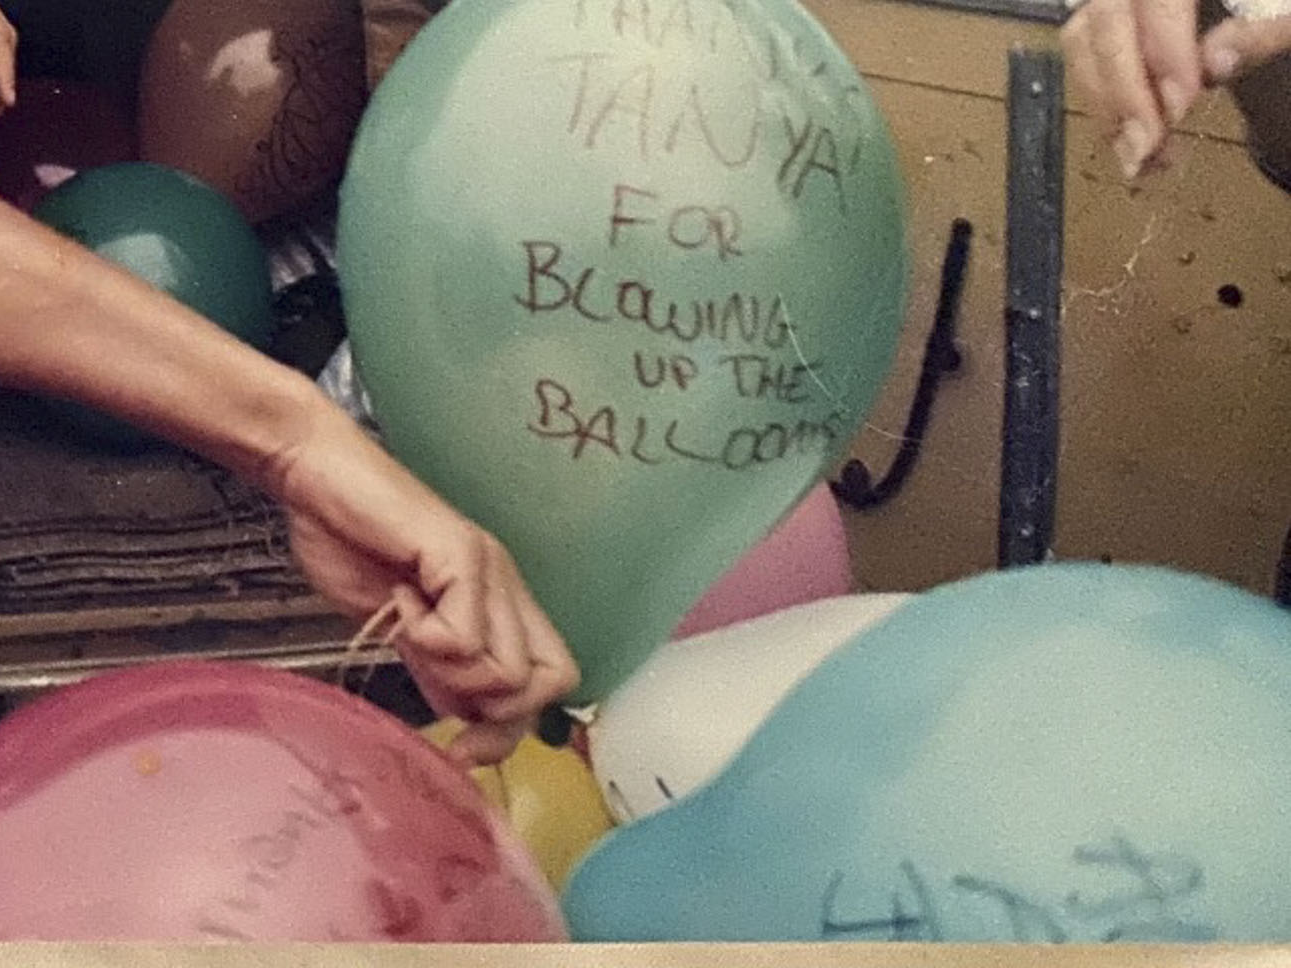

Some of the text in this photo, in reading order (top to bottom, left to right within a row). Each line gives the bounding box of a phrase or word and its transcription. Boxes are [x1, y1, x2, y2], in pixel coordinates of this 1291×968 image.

[610, 184, 743, 260] FOR
[516, 240, 797, 348] BLOWING
[633, 351, 823, 403] UP THE
